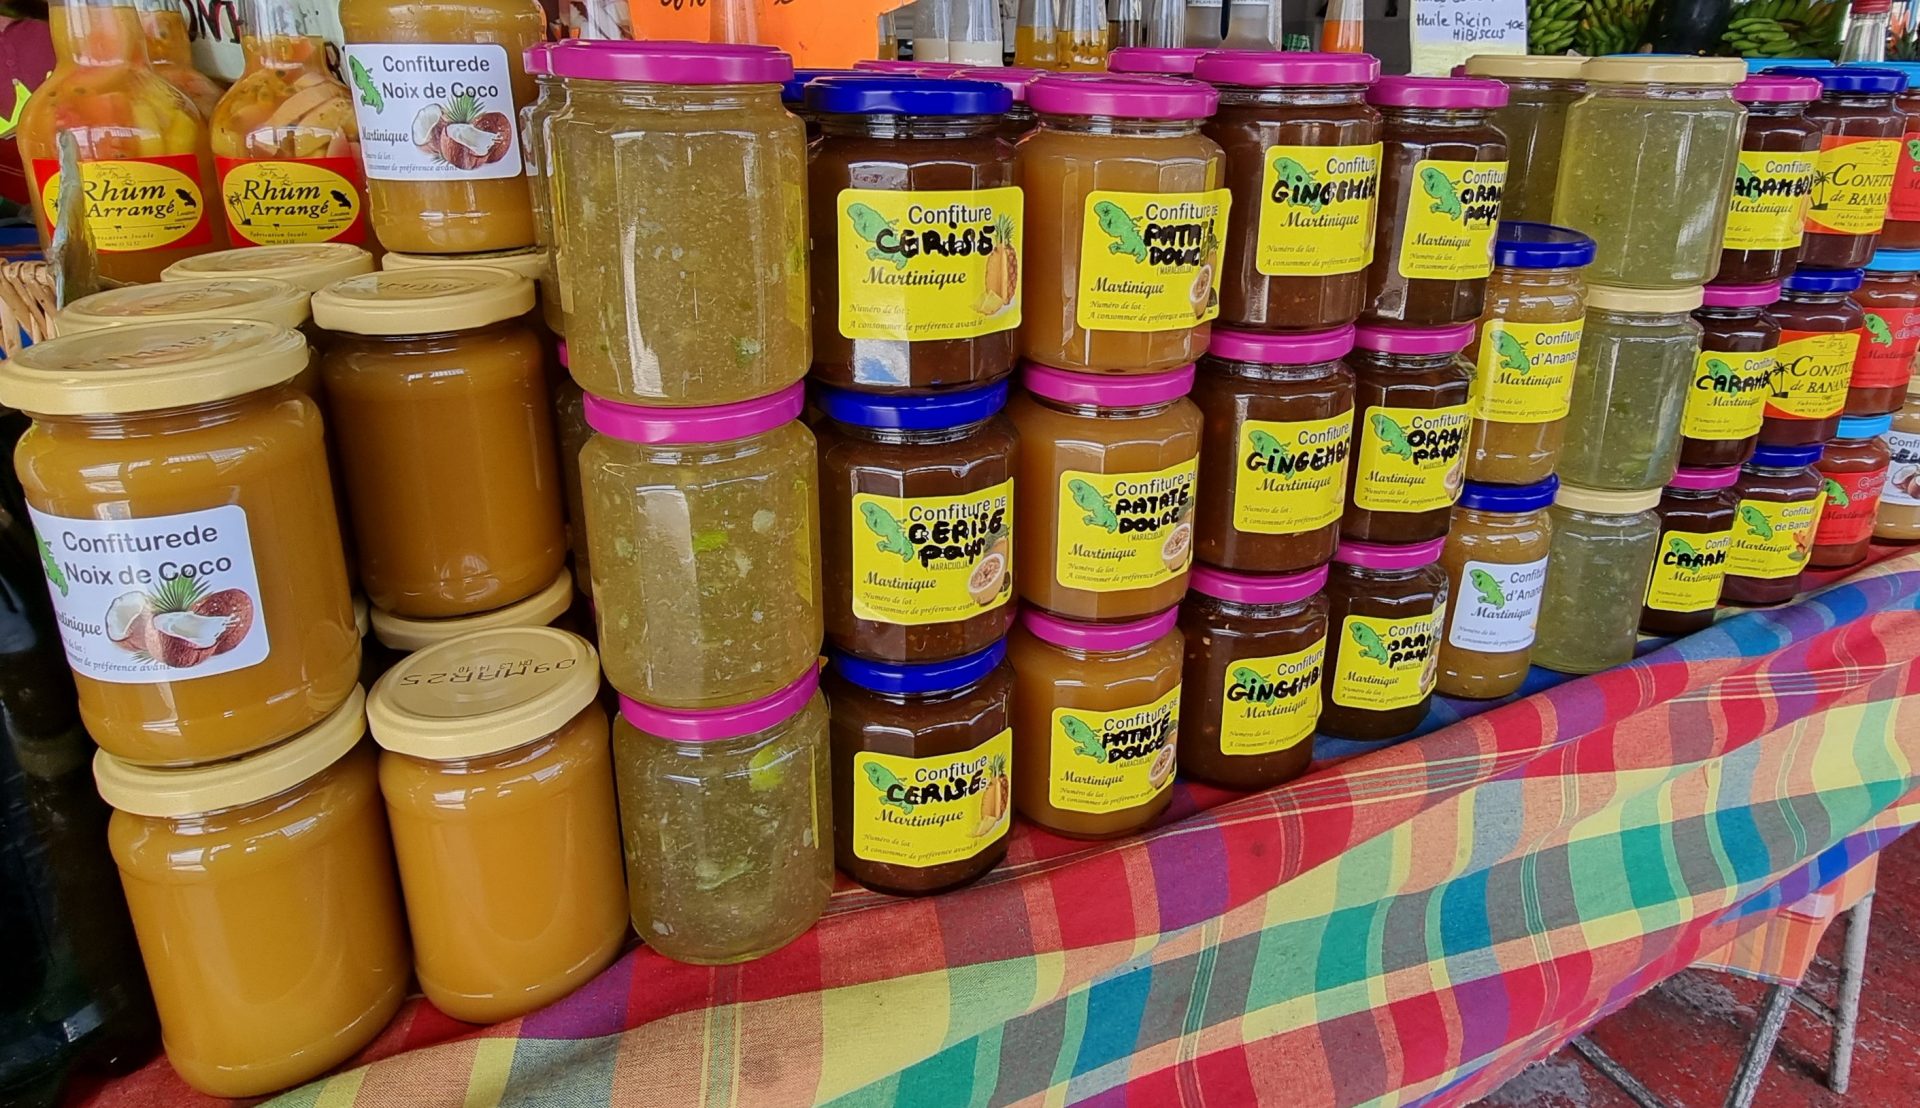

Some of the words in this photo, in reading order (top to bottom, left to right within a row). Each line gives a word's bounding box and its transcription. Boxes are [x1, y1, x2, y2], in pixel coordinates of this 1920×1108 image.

[1416, 10, 1450, 27] Huile
[1455, 11, 1491, 28] Ricin
[382, 55, 490, 73] Confiturede
[382, 82, 419, 98] Noix
[422, 82, 447, 98] de
[451, 82, 498, 98] Coco
[1830, 189, 1845, 202] de
[85, 200, 175, 220] Arrangé
[251, 200, 329, 219] Arrangé
[908, 205, 992, 225] Confiture
[1281, 212, 1359, 230] Martinique
[1411, 232, 1471, 251] Martinique
[863, 267, 967, 290] Martinique
[1090, 277, 1165, 299] Martinique
[849, 303, 880, 314] Numéro
[881, 304, 892, 314] de
[857, 320, 901, 330] consommer
[1493, 372, 1563, 388] Martinique
[1790, 380, 1804, 391] de
[1298, 424, 1350, 446] Confiture
[1115, 474, 1184, 497] Confiture
[1256, 476, 1331, 495] Martinique
[1365, 470, 1426, 487] Martinique
[909, 499, 990, 522] Confiture
[908, 508, 1005, 545] CERISE
[1119, 507, 1179, 534] DOUCE
[62, 525, 218, 553] Confiturede
[1068, 544, 1137, 562] Martinique
[64, 561, 113, 585] Noix
[119, 566, 152, 585] de
[158, 556, 232, 582] Coco
[863, 571, 937, 593] Martinique
[1470, 606, 1533, 621] Martinique
[1343, 671, 1399, 688] Martinique
[1104, 703, 1167, 732] Confiture
[1240, 697, 1308, 719] Martinique
[915, 755, 987, 783] Confiture
[1060, 770, 1124, 788] Martinique
[875, 809, 964, 827] Martinique
